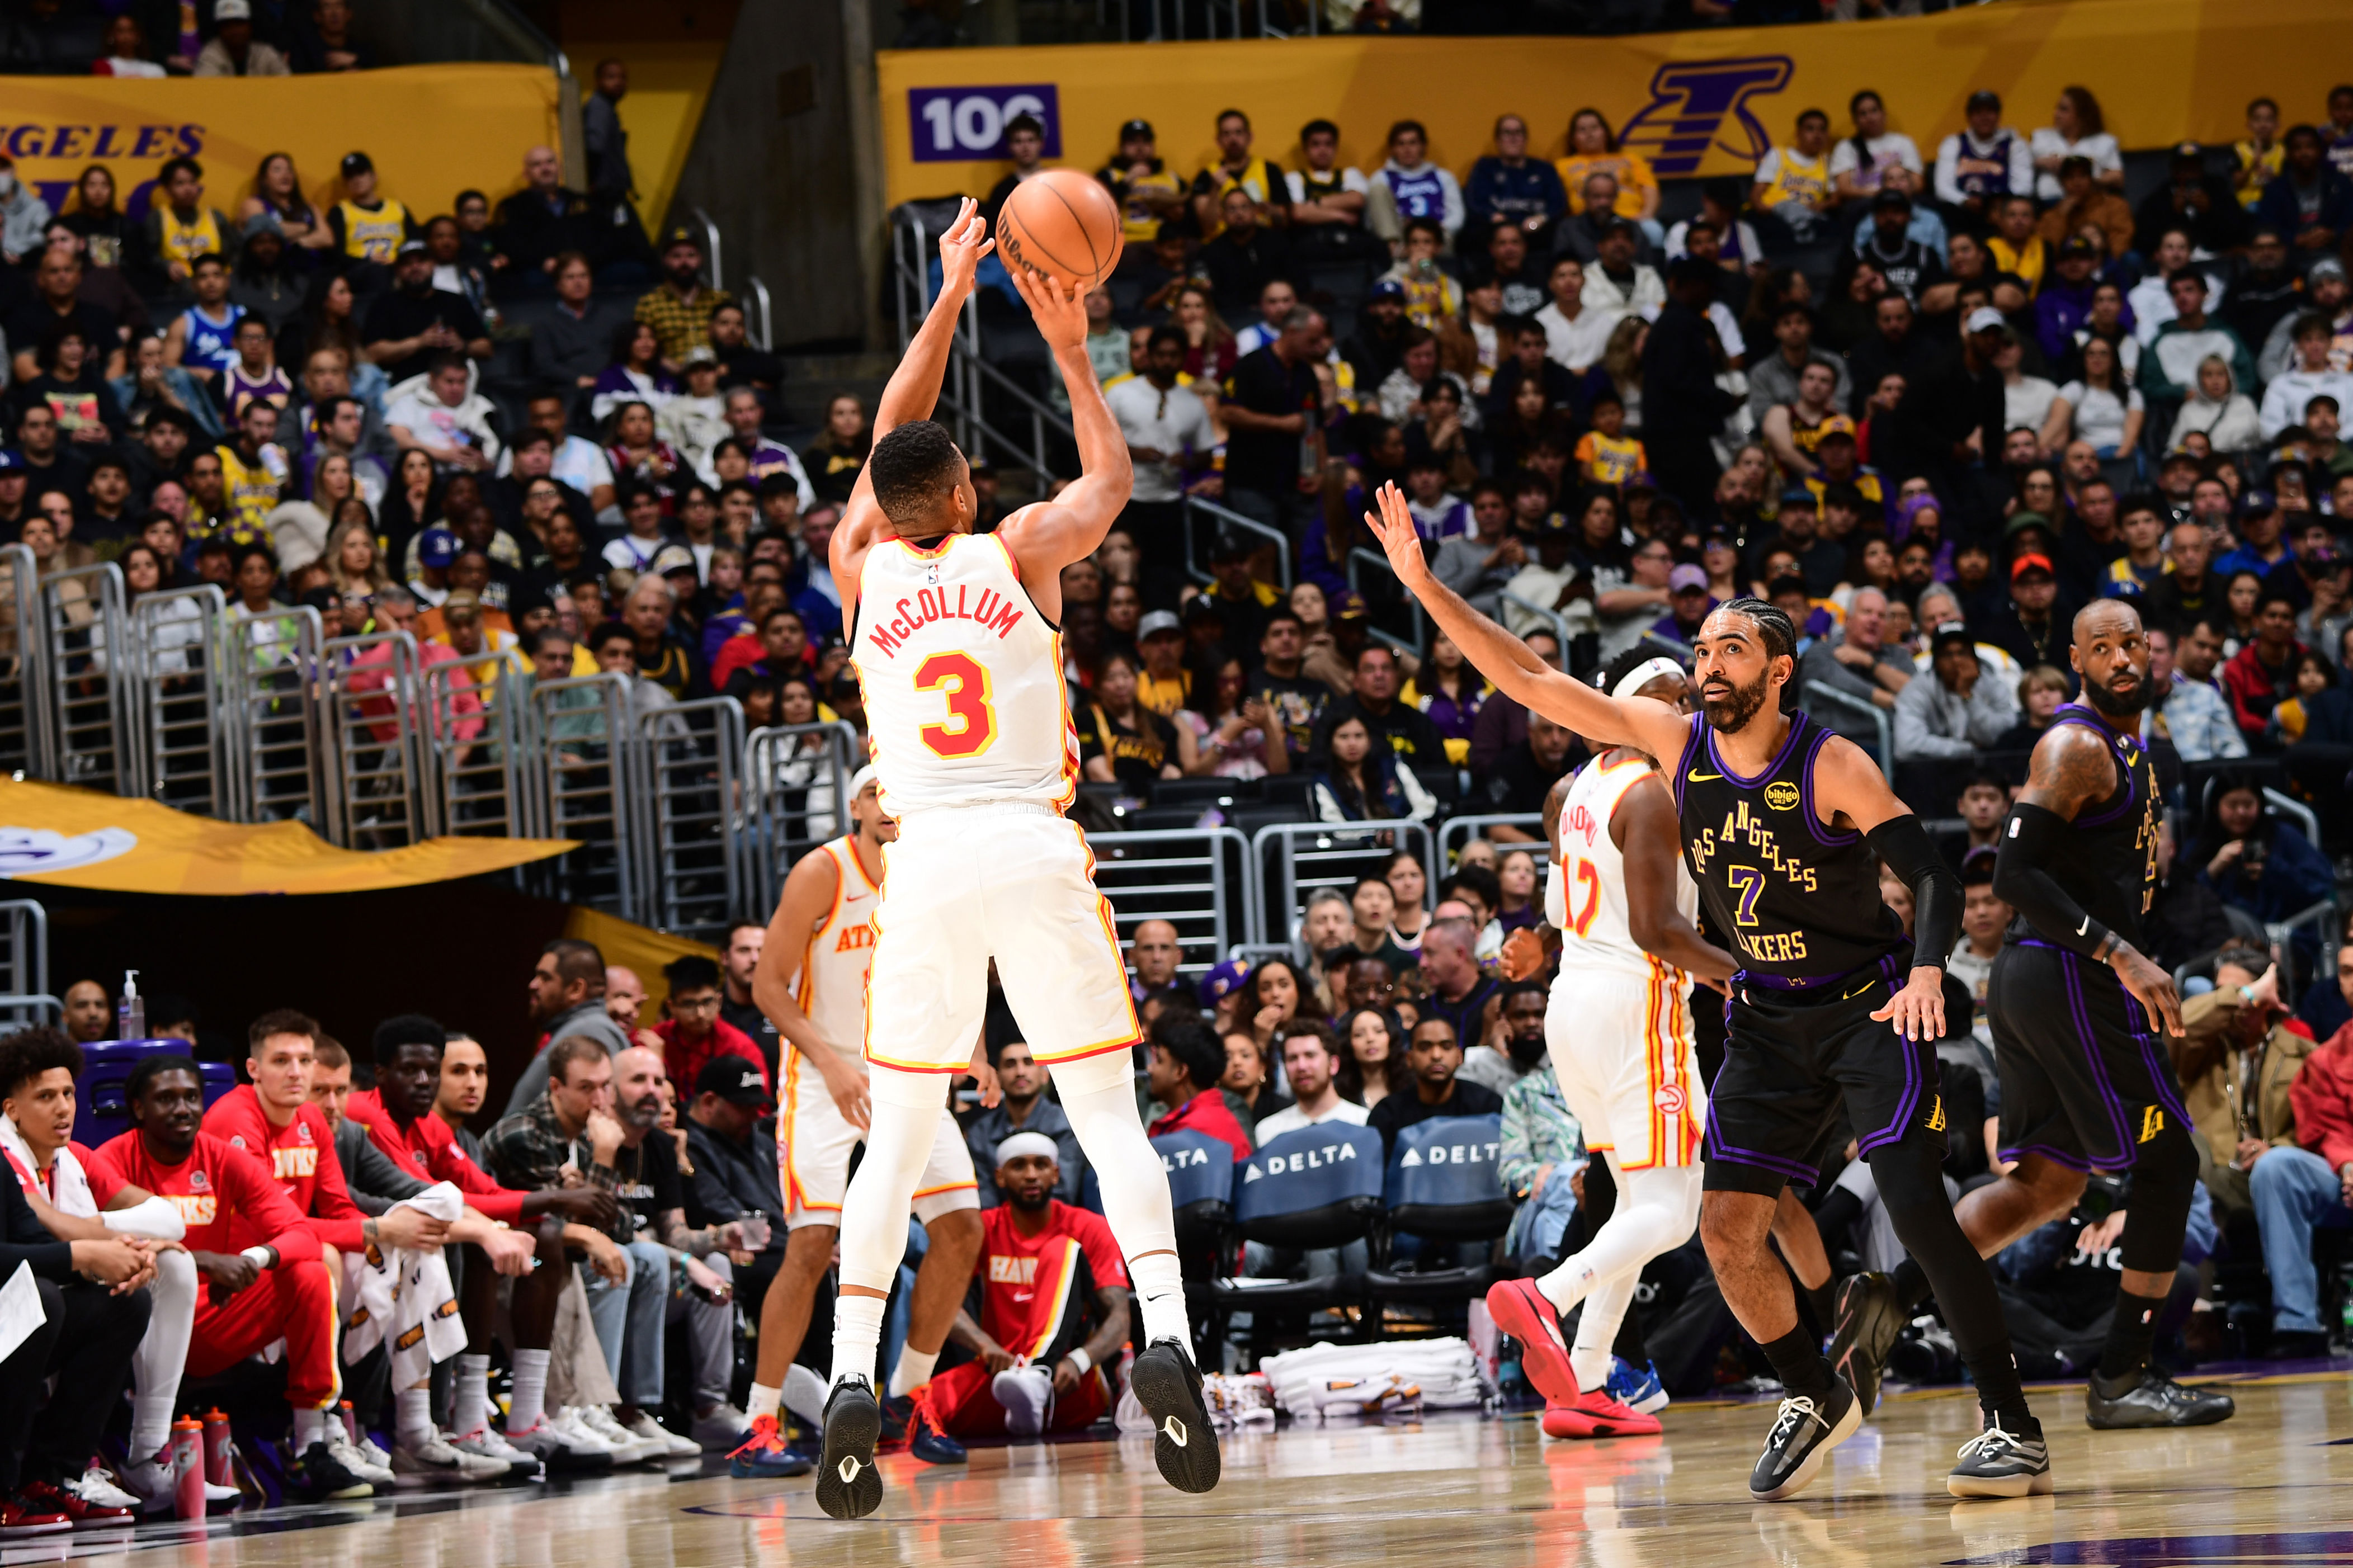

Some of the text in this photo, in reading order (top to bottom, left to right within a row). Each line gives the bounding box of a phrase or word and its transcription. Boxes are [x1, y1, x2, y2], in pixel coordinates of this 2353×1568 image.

[0, 123, 206, 158] GELES
[869, 584, 1024, 659] McCOLLUM
[913, 649, 998, 761] 3
[1768, 788, 1798, 803] bibigo
[1691, 799, 1818, 894] LOS ANGELES
[1560, 852, 1601, 939] 17
[1728, 864, 1766, 927] 7
[1732, 925, 1807, 962] LAKERS
[1162, 1148, 1209, 1173] LTA
[1267, 1142, 1356, 1175] DELTA
[1429, 1142, 1500, 1165] DELT
[989, 1255, 1039, 1285] HAW
